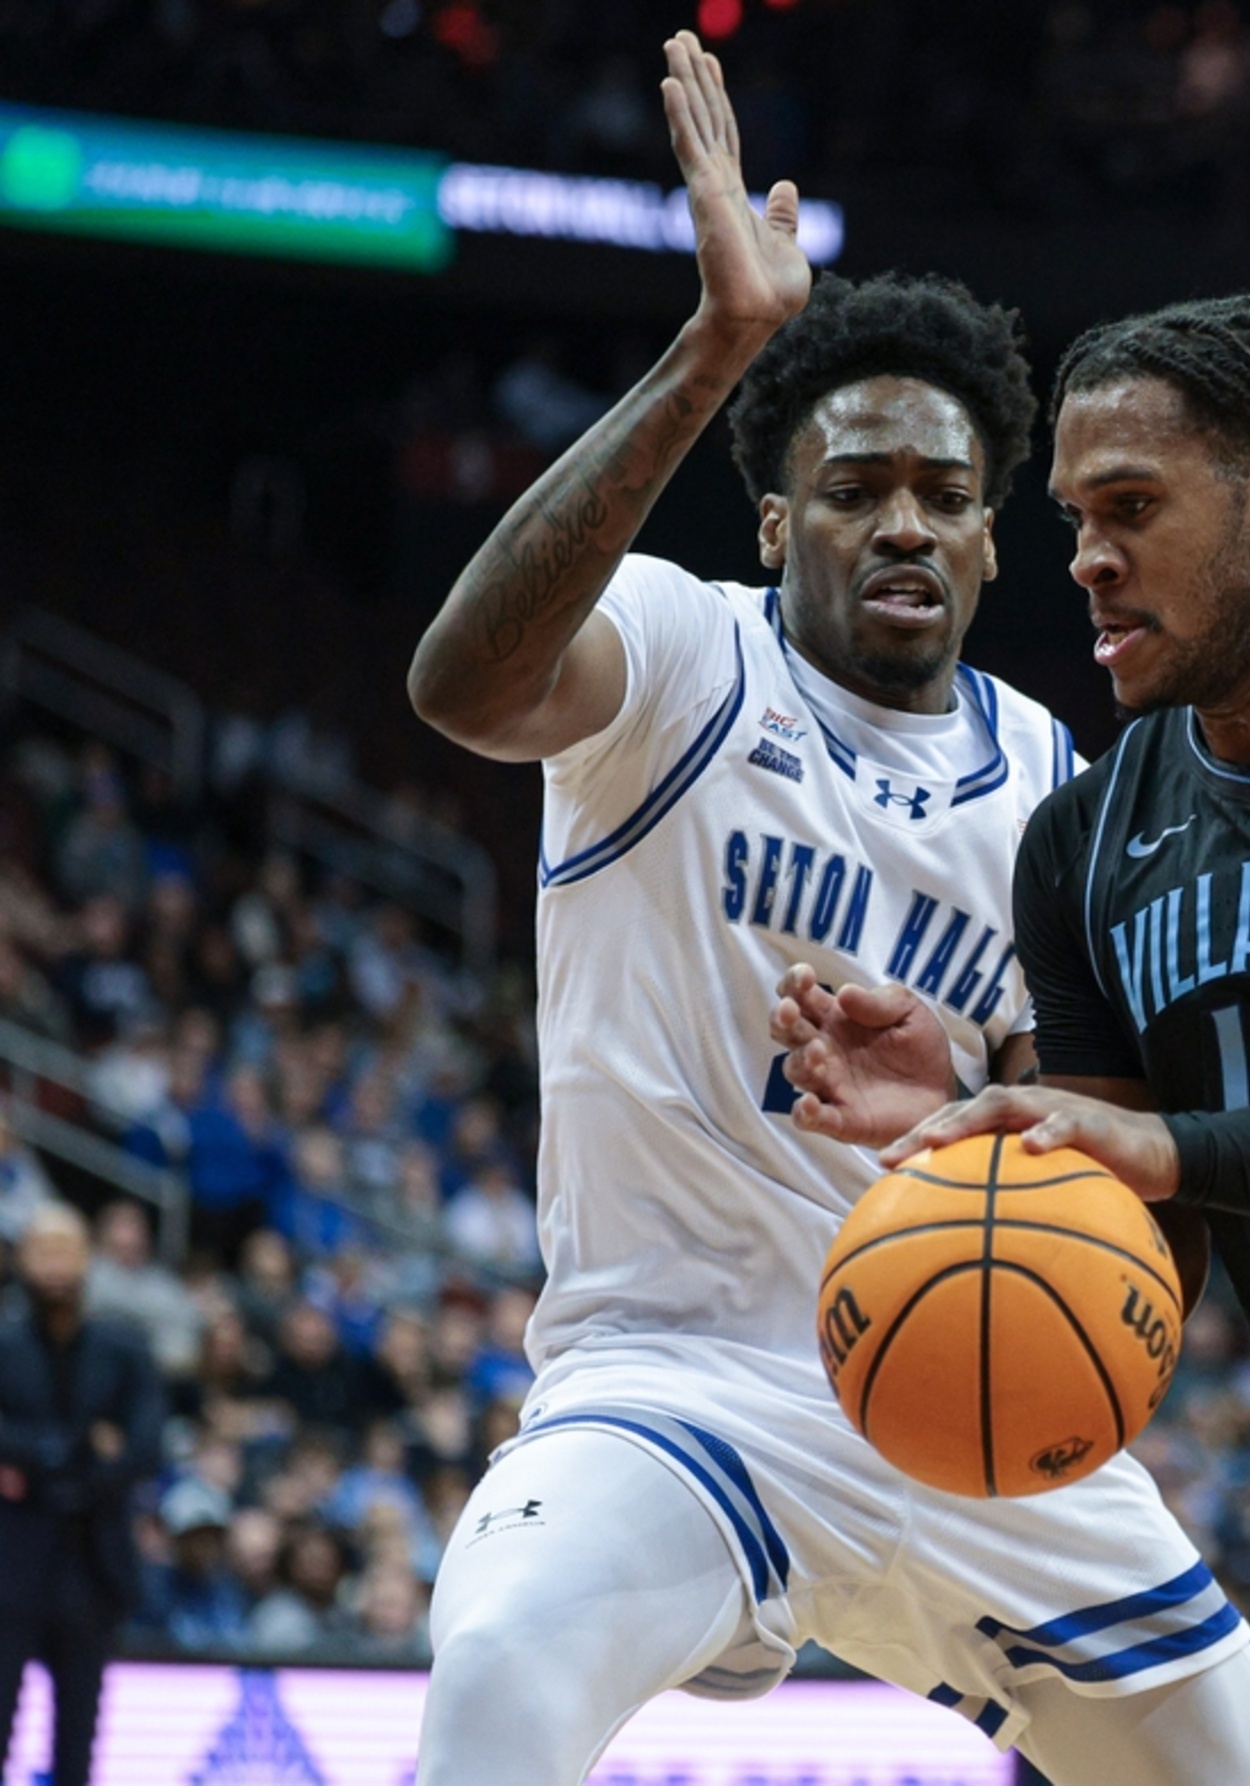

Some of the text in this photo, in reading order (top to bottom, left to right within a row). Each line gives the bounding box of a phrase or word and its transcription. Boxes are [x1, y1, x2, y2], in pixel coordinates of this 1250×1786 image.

[474, 484, 608, 664] Believe
[747, 748, 805, 784] CHANGE
[759, 736, 775, 755] BE
[722, 830, 1017, 1029] SETON HALL
